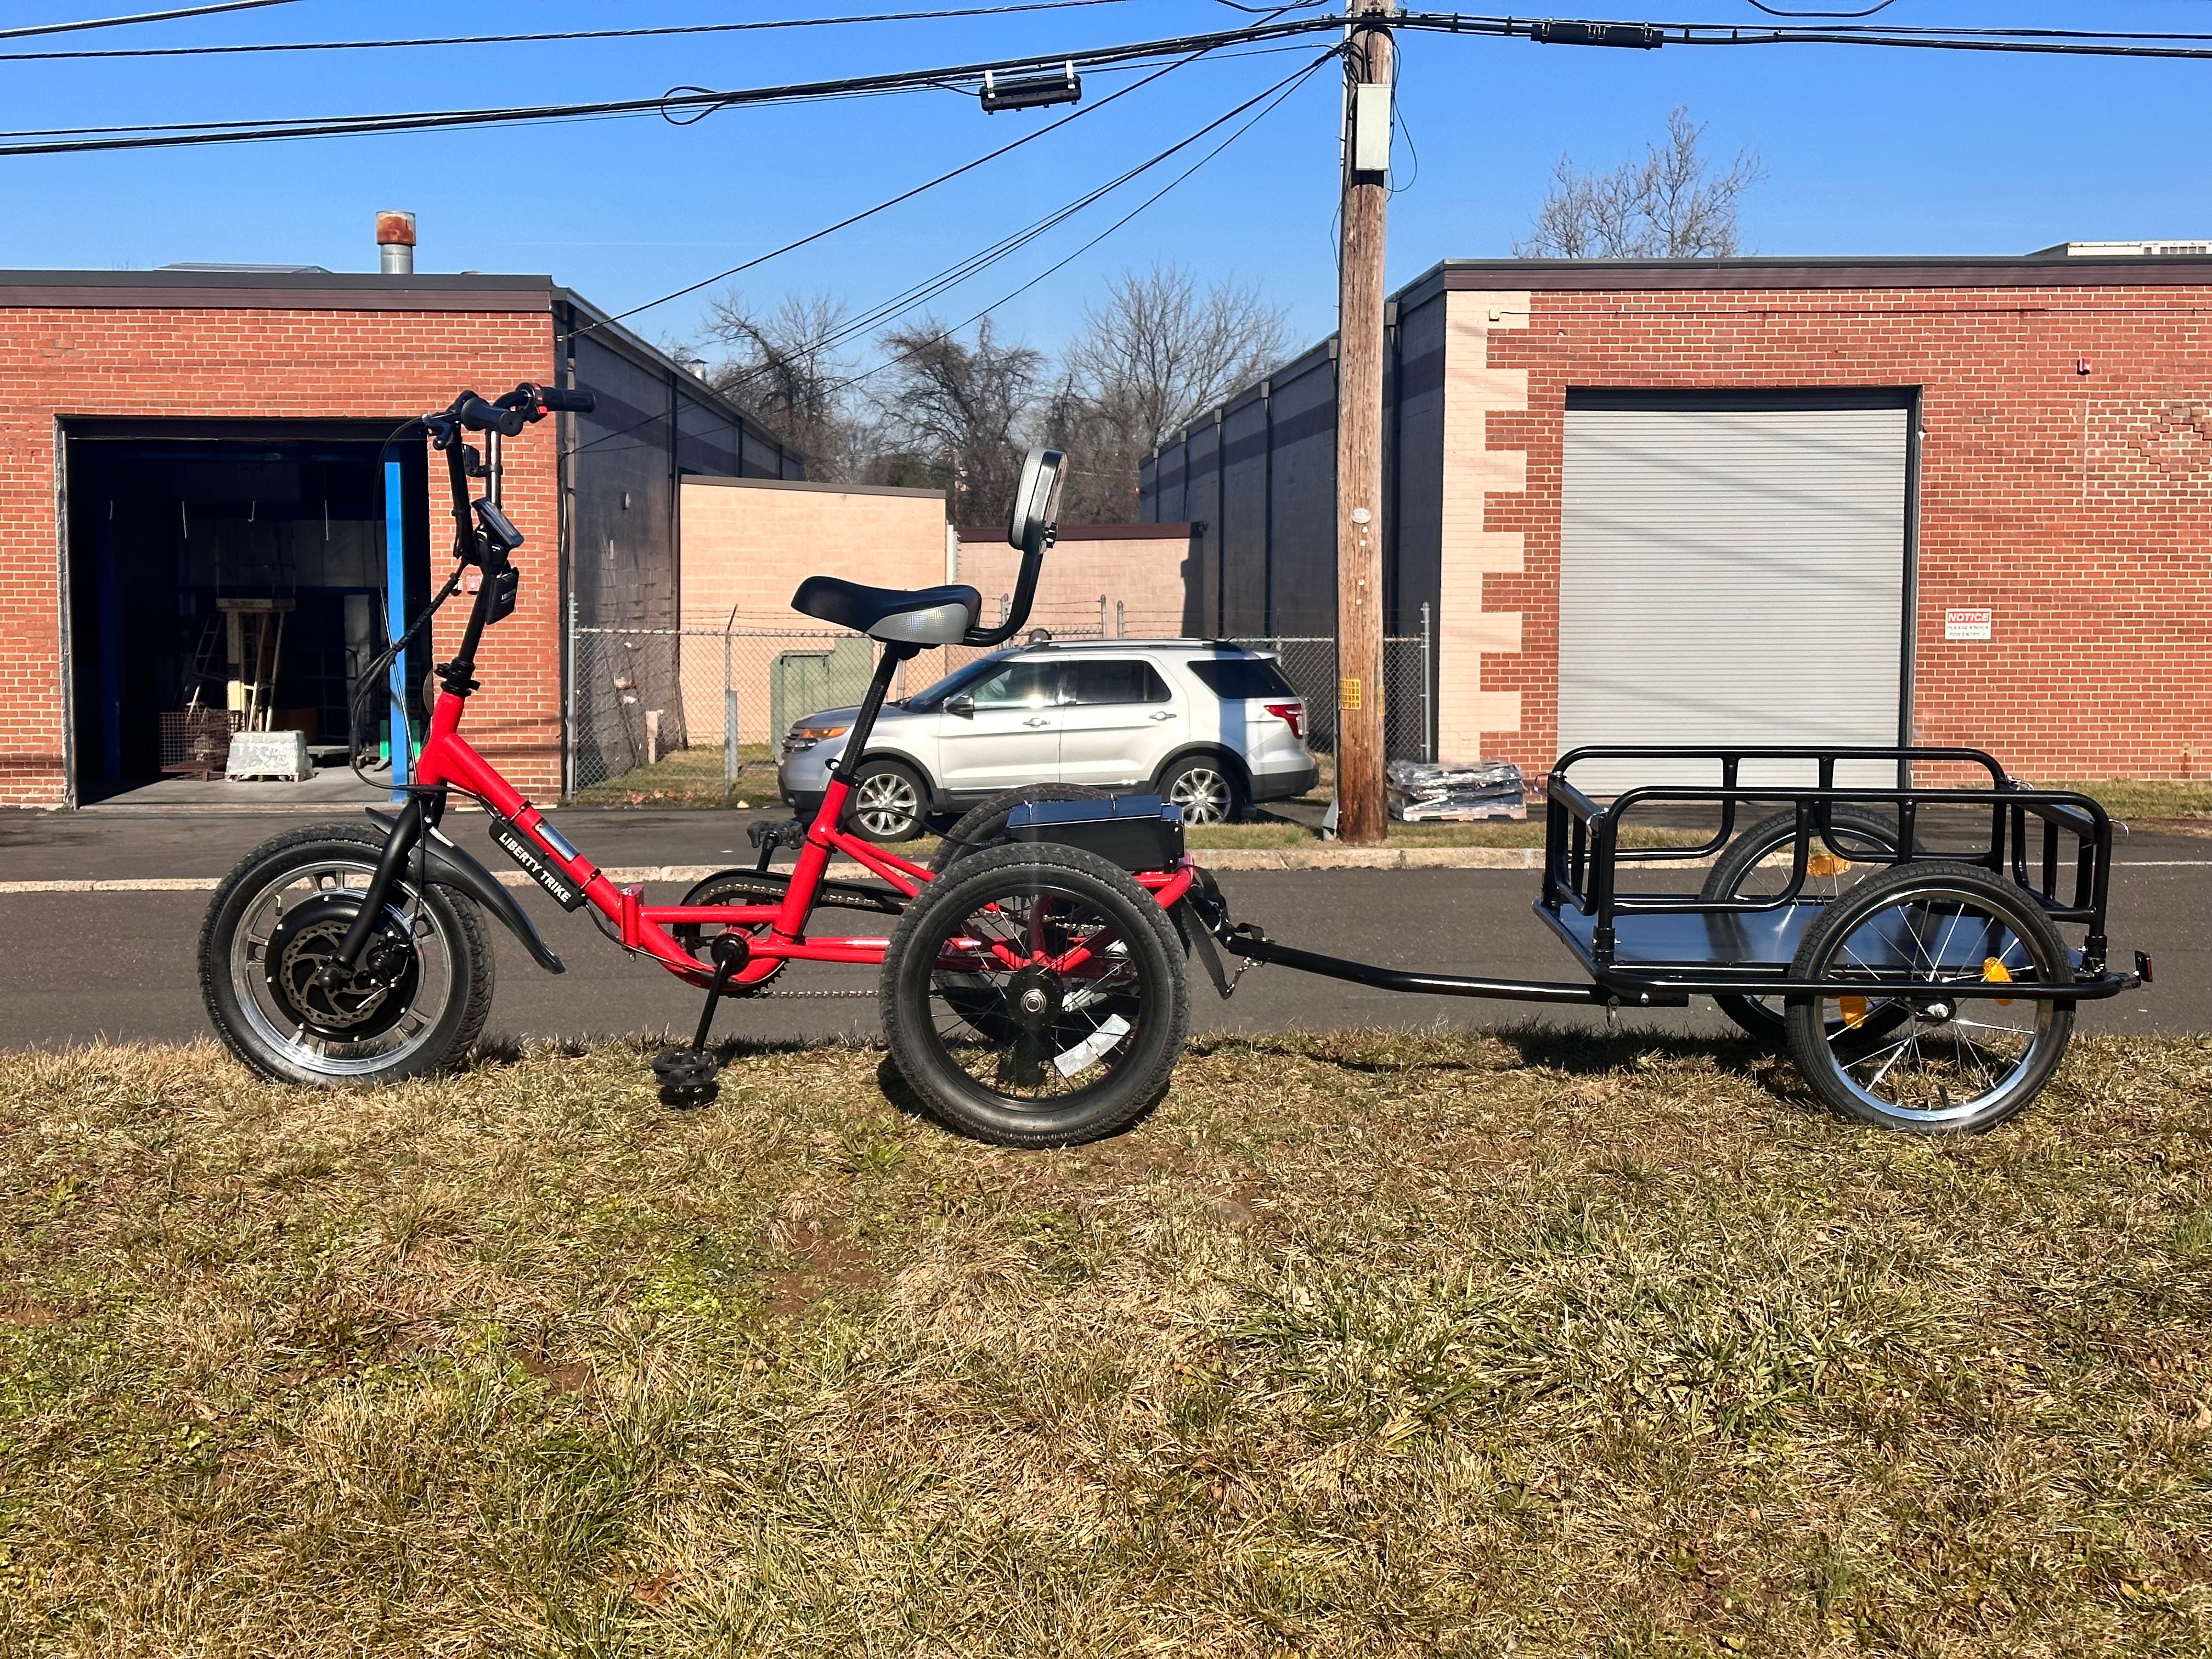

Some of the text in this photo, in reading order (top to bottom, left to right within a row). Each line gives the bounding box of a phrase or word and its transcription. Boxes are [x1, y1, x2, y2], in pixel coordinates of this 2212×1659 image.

[1948, 612, 1989, 622] NOTICE
[499, 832, 571, 902] LIBERTY TRIKE
